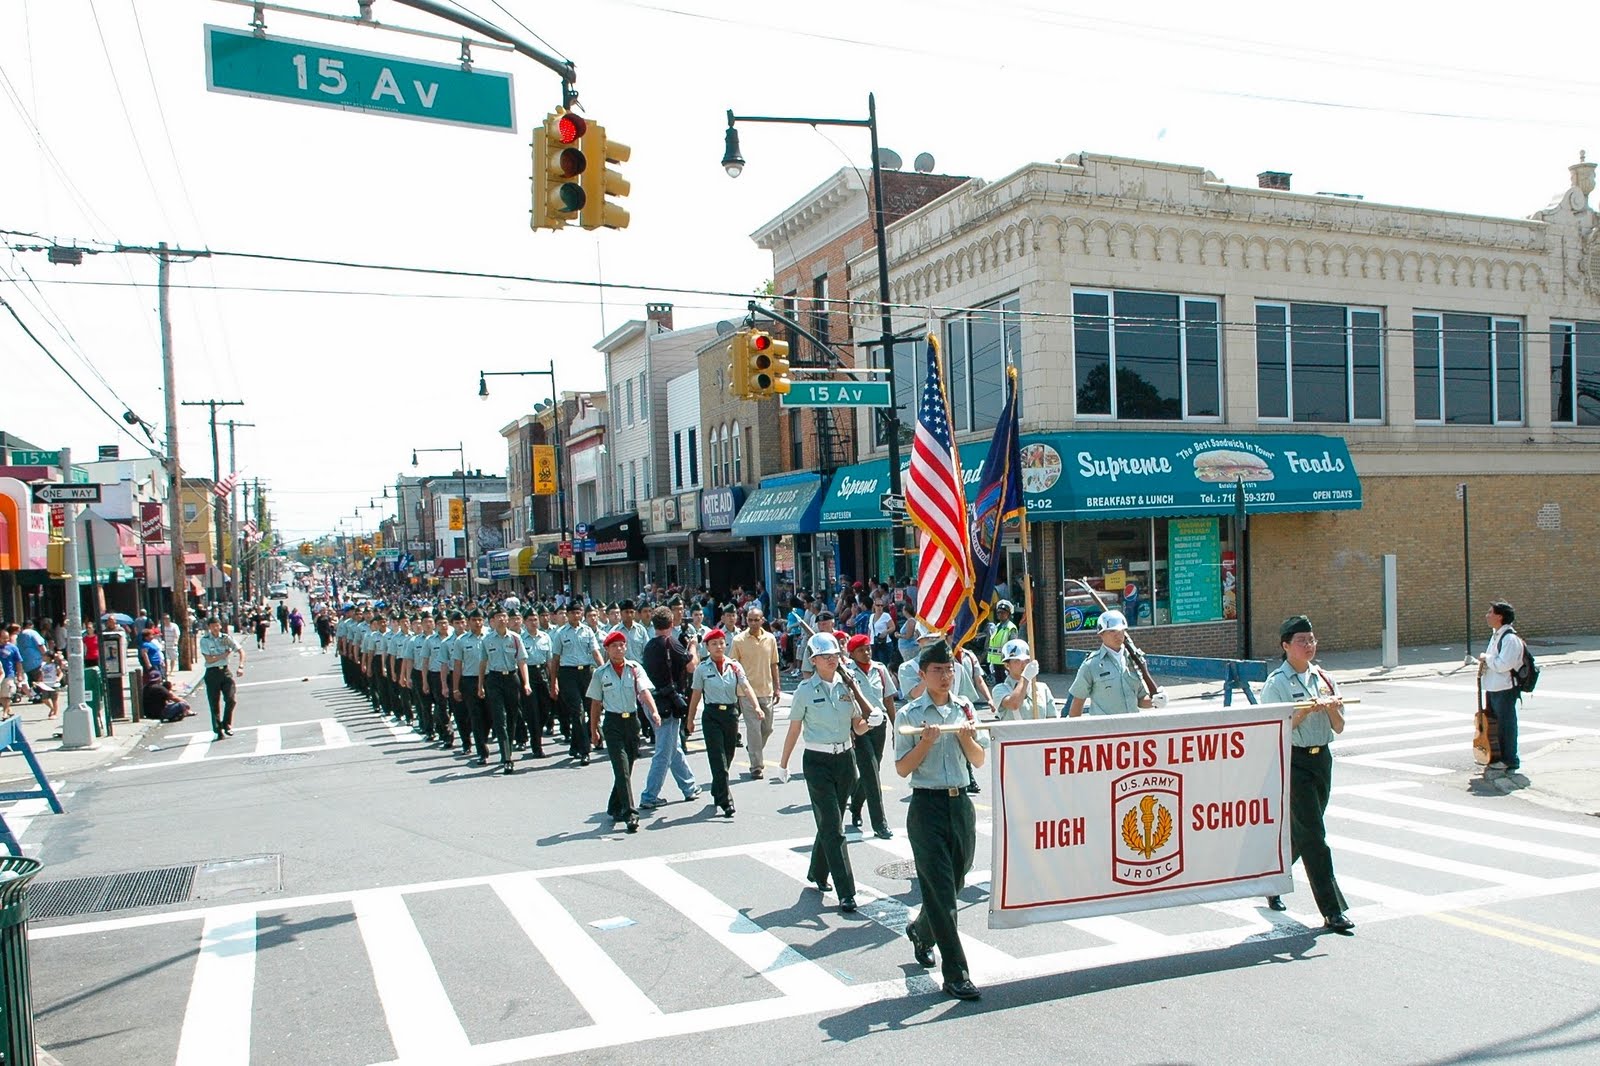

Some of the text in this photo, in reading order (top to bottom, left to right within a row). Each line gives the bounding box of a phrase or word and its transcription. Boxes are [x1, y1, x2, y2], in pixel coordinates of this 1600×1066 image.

[292, 53, 348, 95] 15
[809, 386, 830, 402] 15
[1193, 440, 1211, 452] Best
[1211, 438, 1245, 450] Sandwich
[1245, 442, 1254, 451] In
[22, 452, 40, 465] 15
[1077, 450, 1345, 482] Supreme Foods
[42, 489, 92, 498] ONE WAY
[837, 475, 878, 500] Supreme
[1312, 490, 1331, 500] OPEN
[704, 494, 719, 514] RITE
[719, 492, 732, 512] AID
[1086, 494, 1174, 507] BREAKFAST & LUNCH
[739, 506, 798, 523] LAUNDROMAT
[1083, 616, 1099, 627] AT
[1044, 730, 1246, 777] FRANCIS LEWIS
[1120, 776, 1175, 792] U.S. ARMY
[1192, 797, 1275, 832] SCHOOL
[1035, 816, 1086, 850] HIGH
[1123, 862, 1173, 878] JROTC
